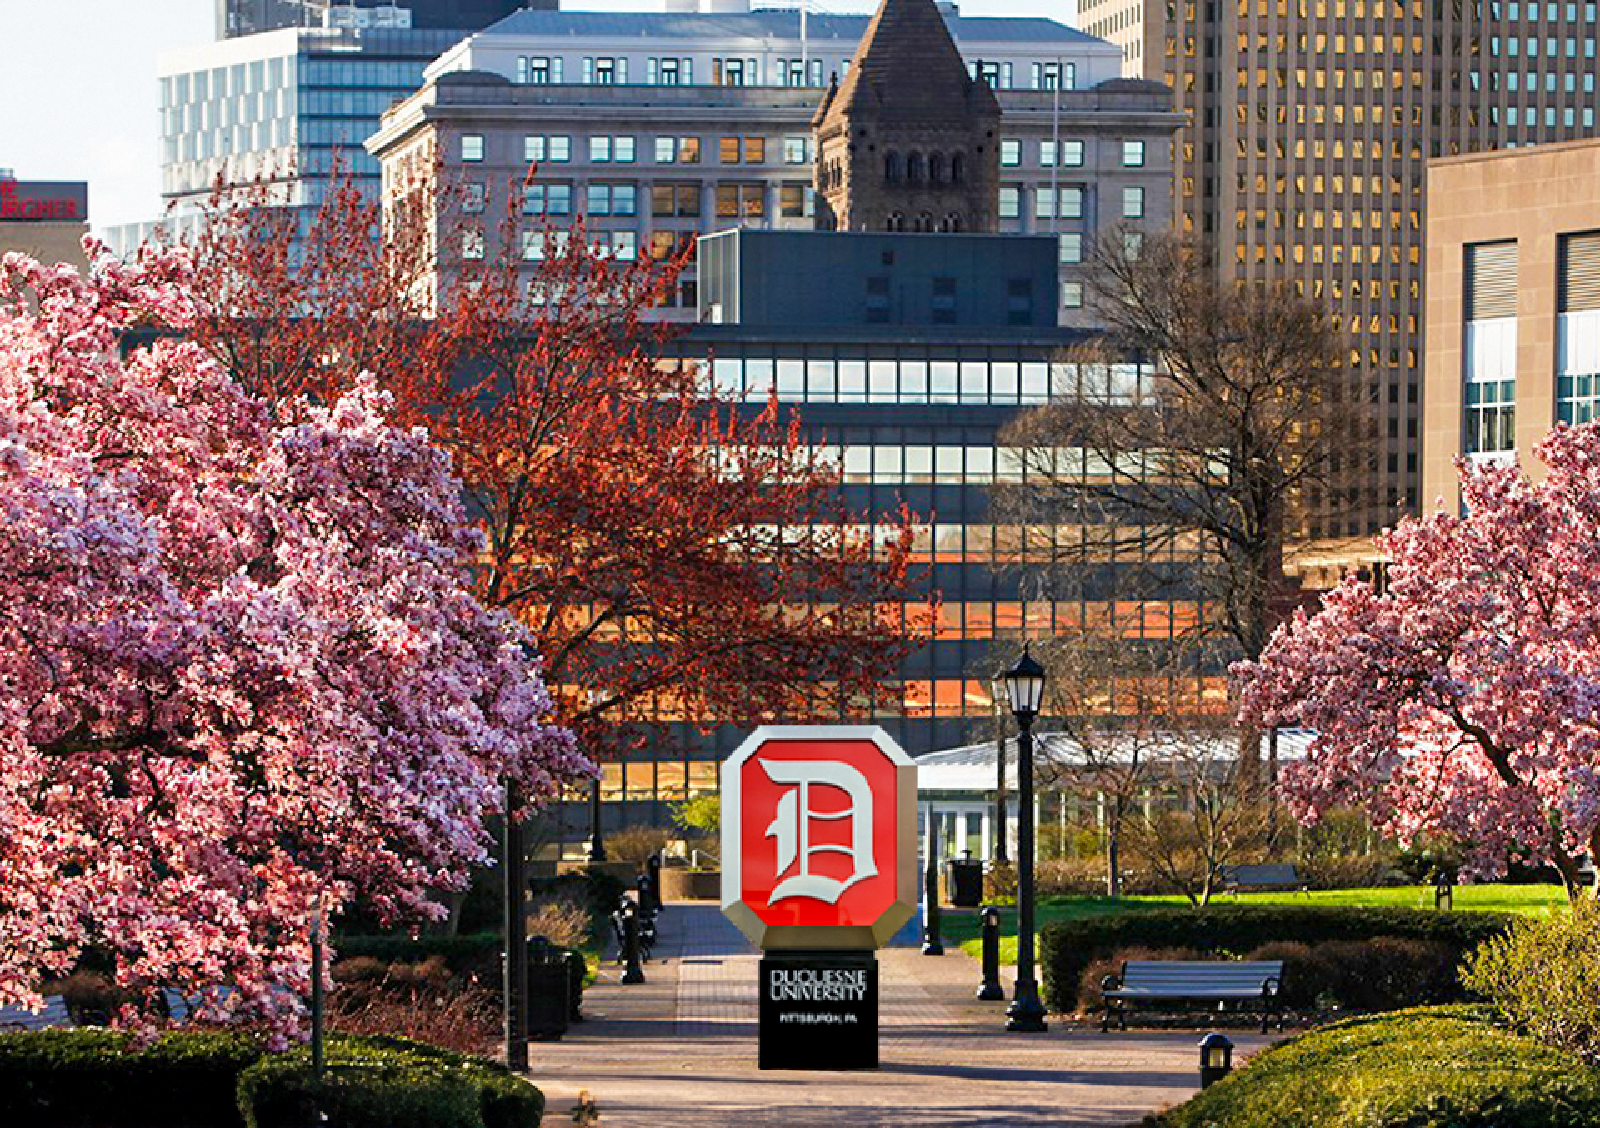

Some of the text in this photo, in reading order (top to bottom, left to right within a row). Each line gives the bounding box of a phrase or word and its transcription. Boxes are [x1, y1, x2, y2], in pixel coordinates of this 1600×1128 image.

[758, 758, 878, 907] D
[770, 969, 867, 986] DUQUESNE
[770, 984, 867, 1001] UNIVERSITY
